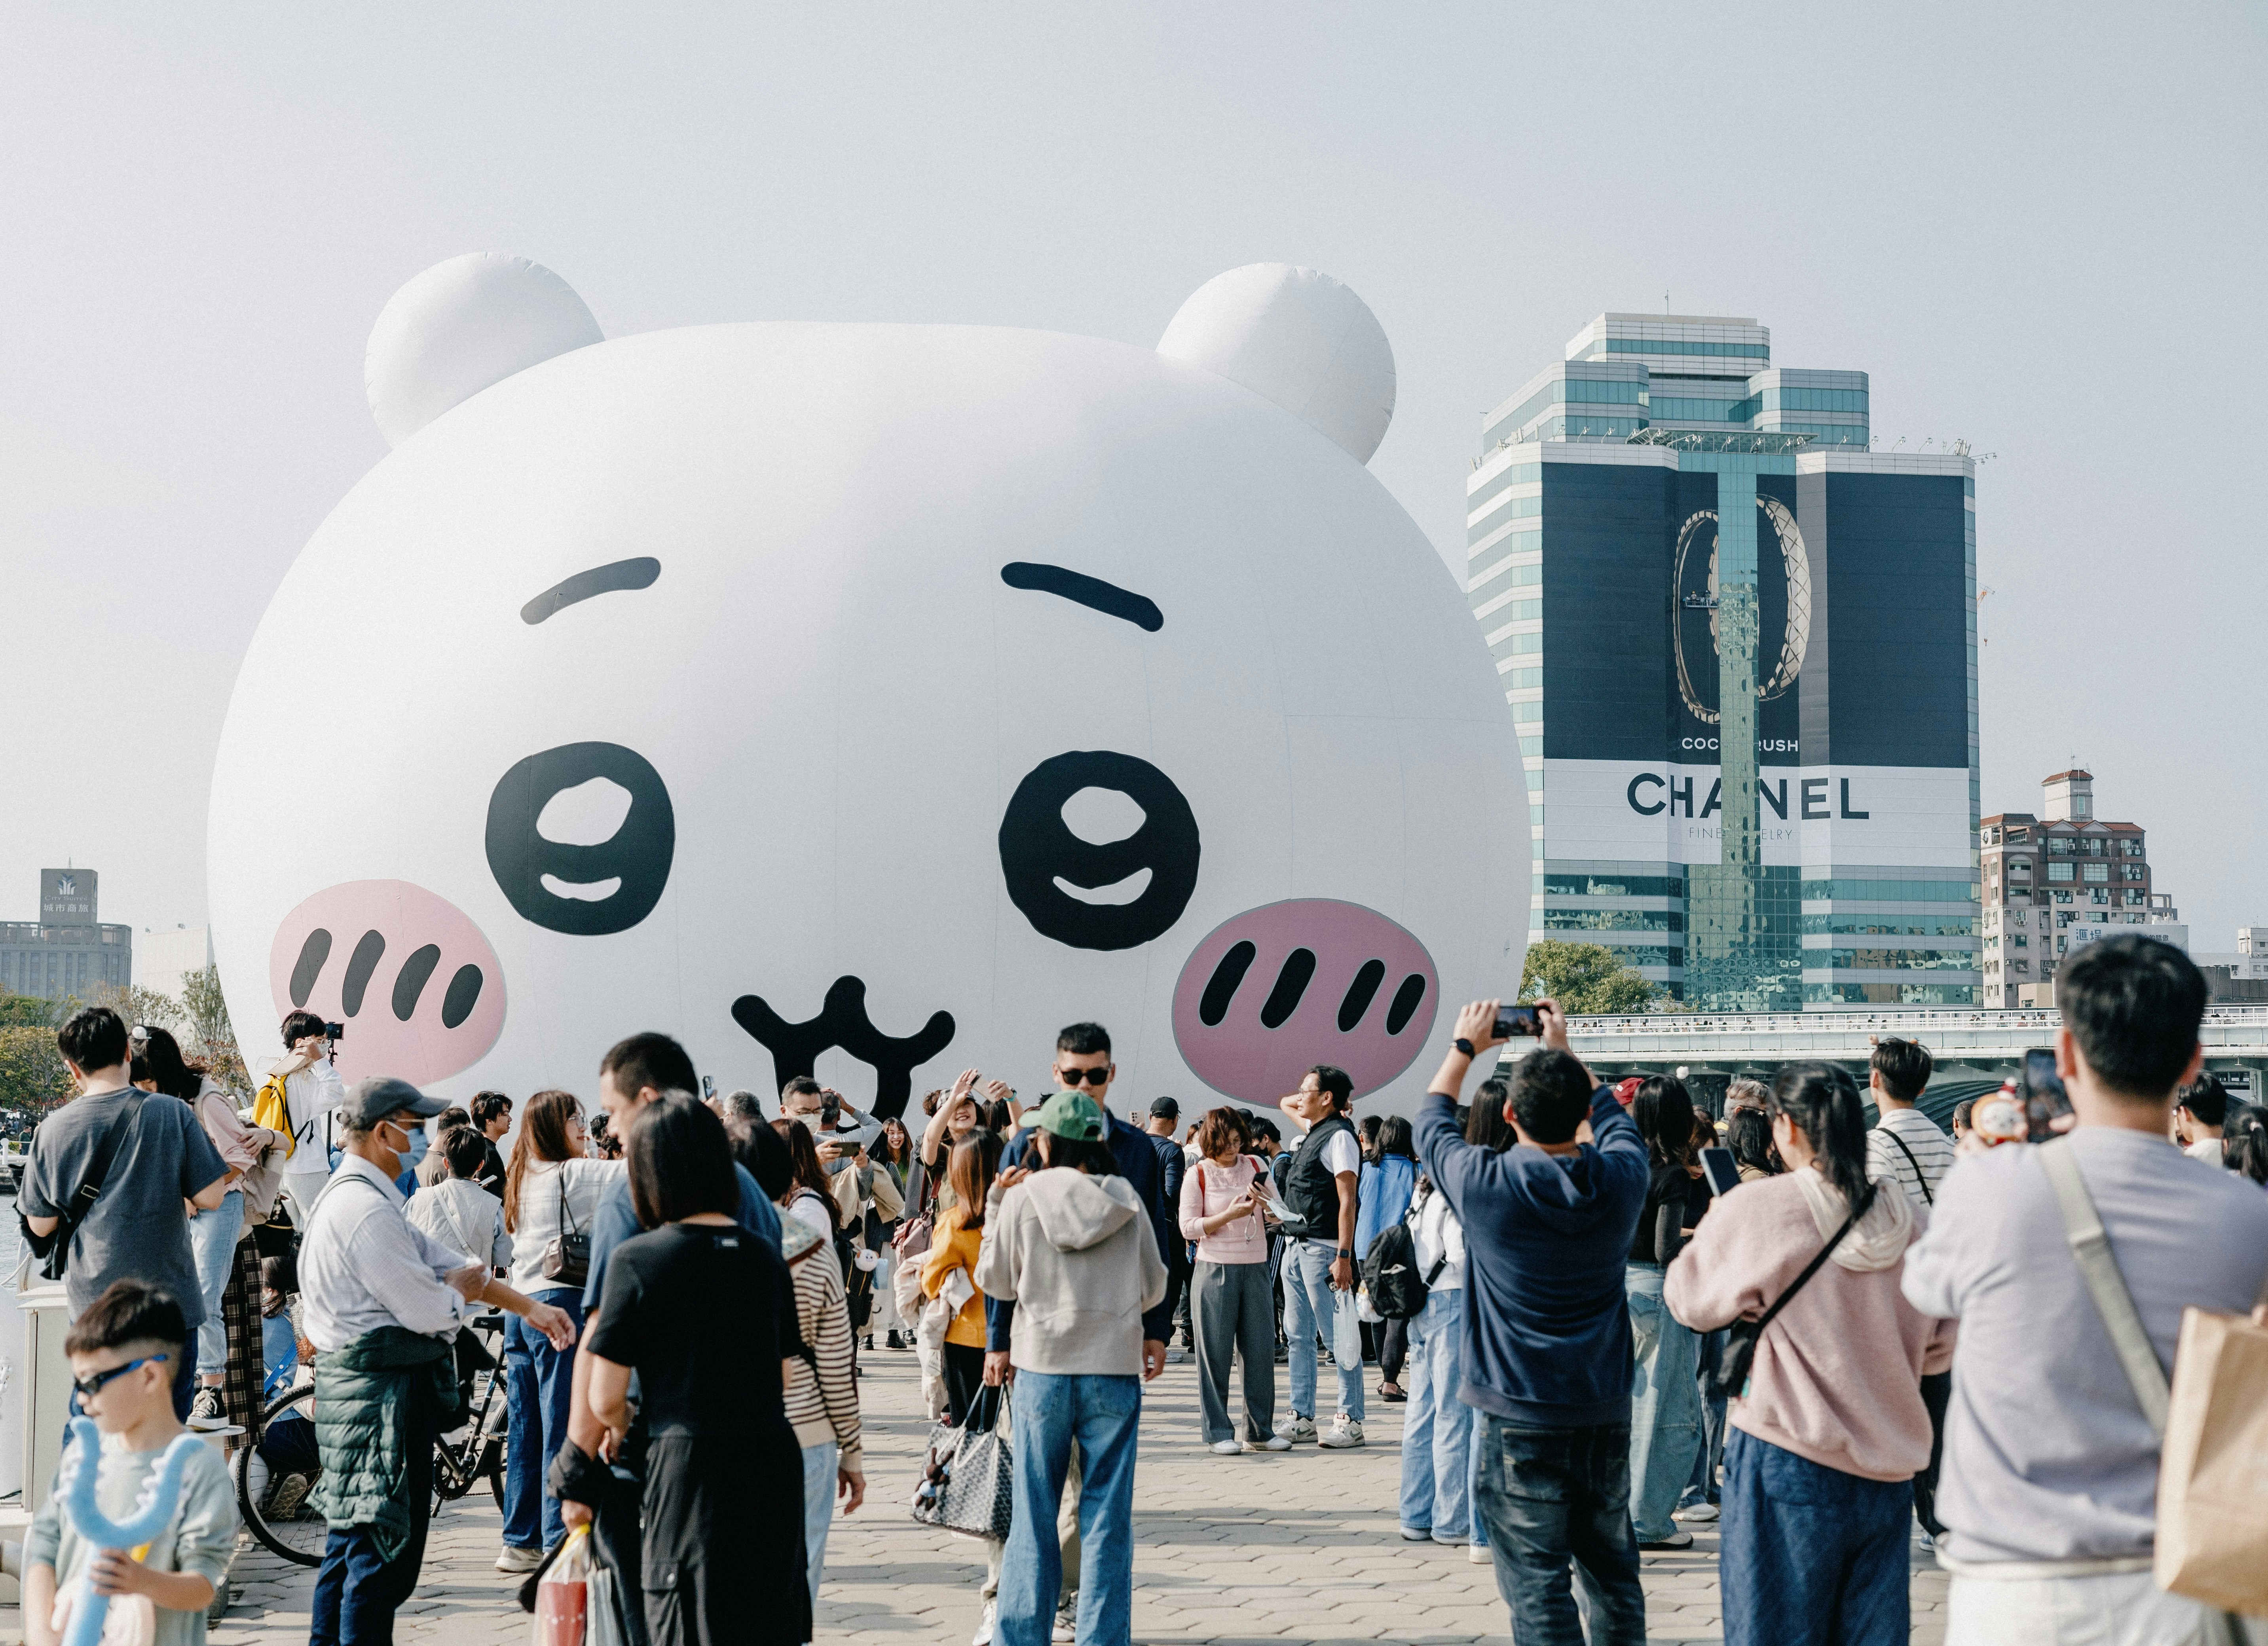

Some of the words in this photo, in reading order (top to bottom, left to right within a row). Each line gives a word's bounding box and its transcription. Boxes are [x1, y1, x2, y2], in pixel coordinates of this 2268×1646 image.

[1682, 737, 1719, 750] COC
[1689, 827, 1721, 839] FINE
[1761, 829, 1792, 840] ELRY
[44, 903, 89, 912] 城市商旅
